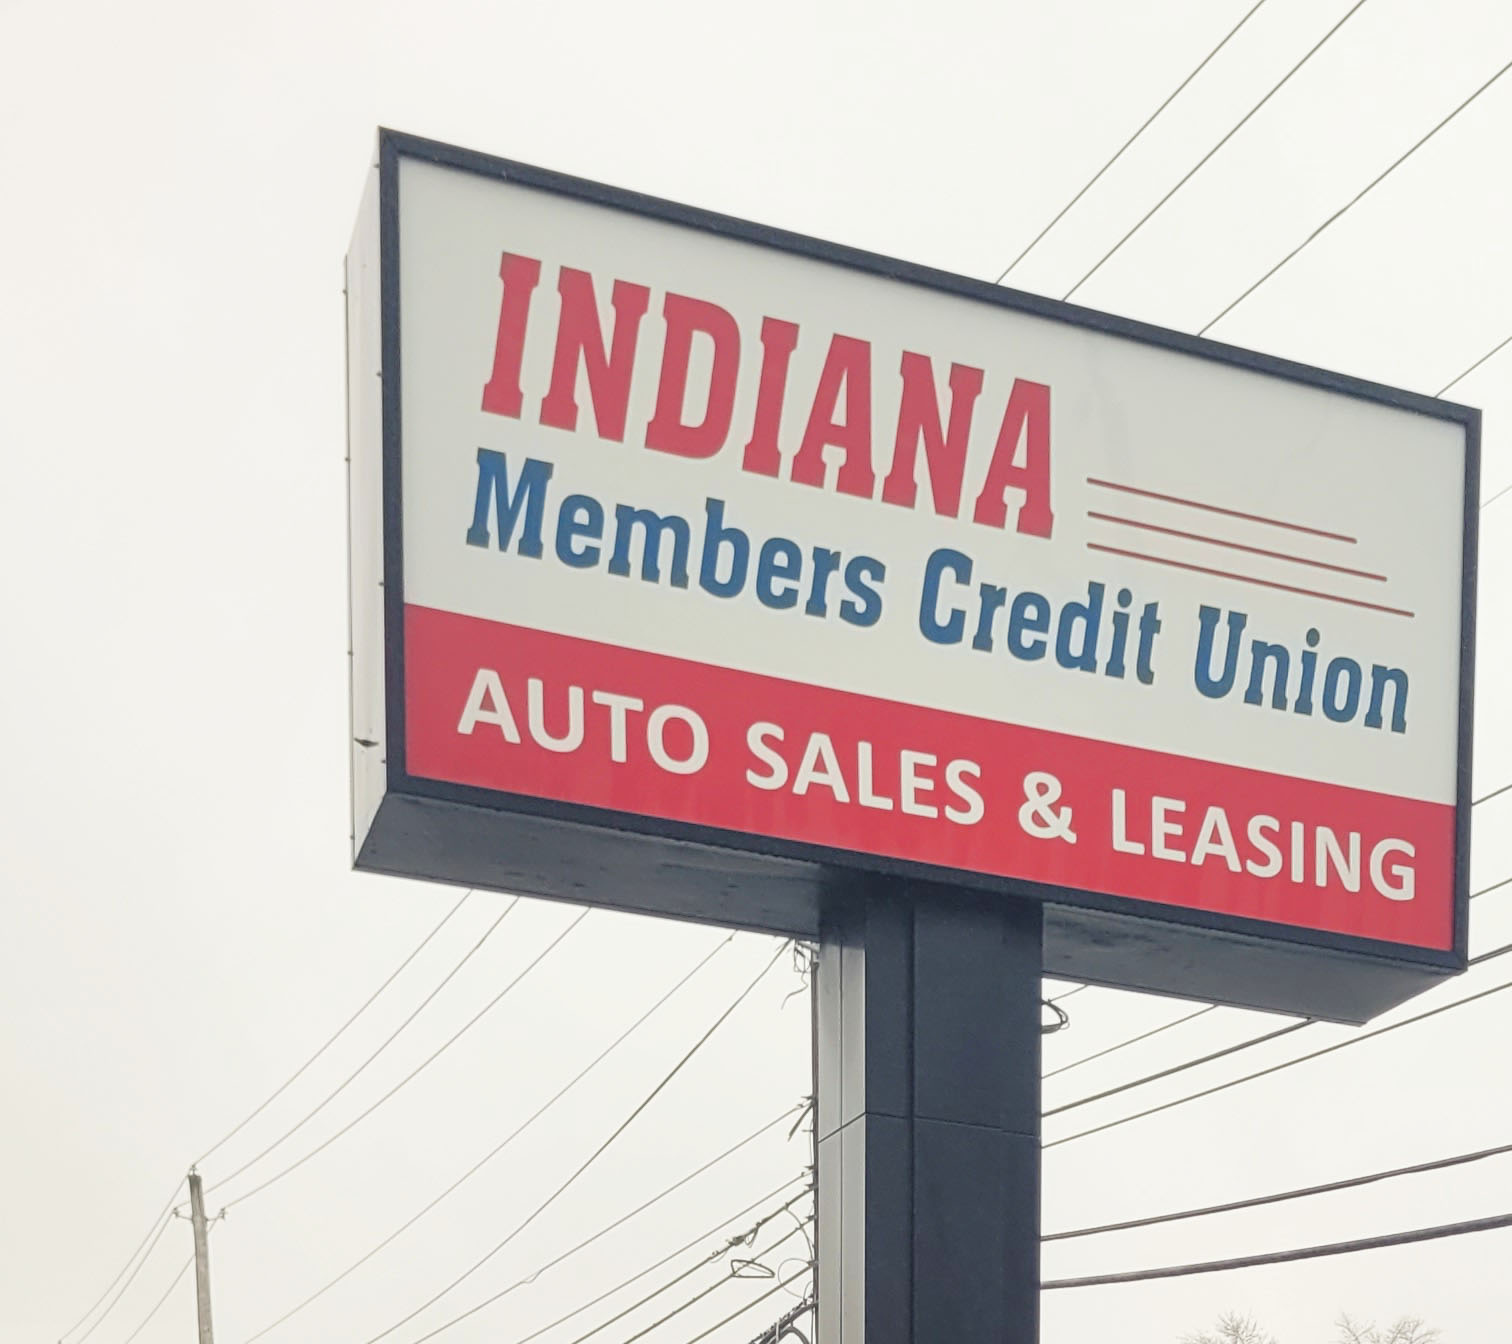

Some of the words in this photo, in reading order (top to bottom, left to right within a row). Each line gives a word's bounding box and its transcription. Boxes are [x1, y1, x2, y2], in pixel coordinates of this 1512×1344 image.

[480, 251, 1054, 538] INDIANA
[465, 447, 886, 627] Members
[918, 547, 1161, 686] Credit
[1194, 604, 1412, 734] Union
[457, 667, 710, 775] AUTO
[745, 721, 986, 826] SALES
[1018, 771, 1077, 844] &
[1111, 787, 1416, 902] LEASING
